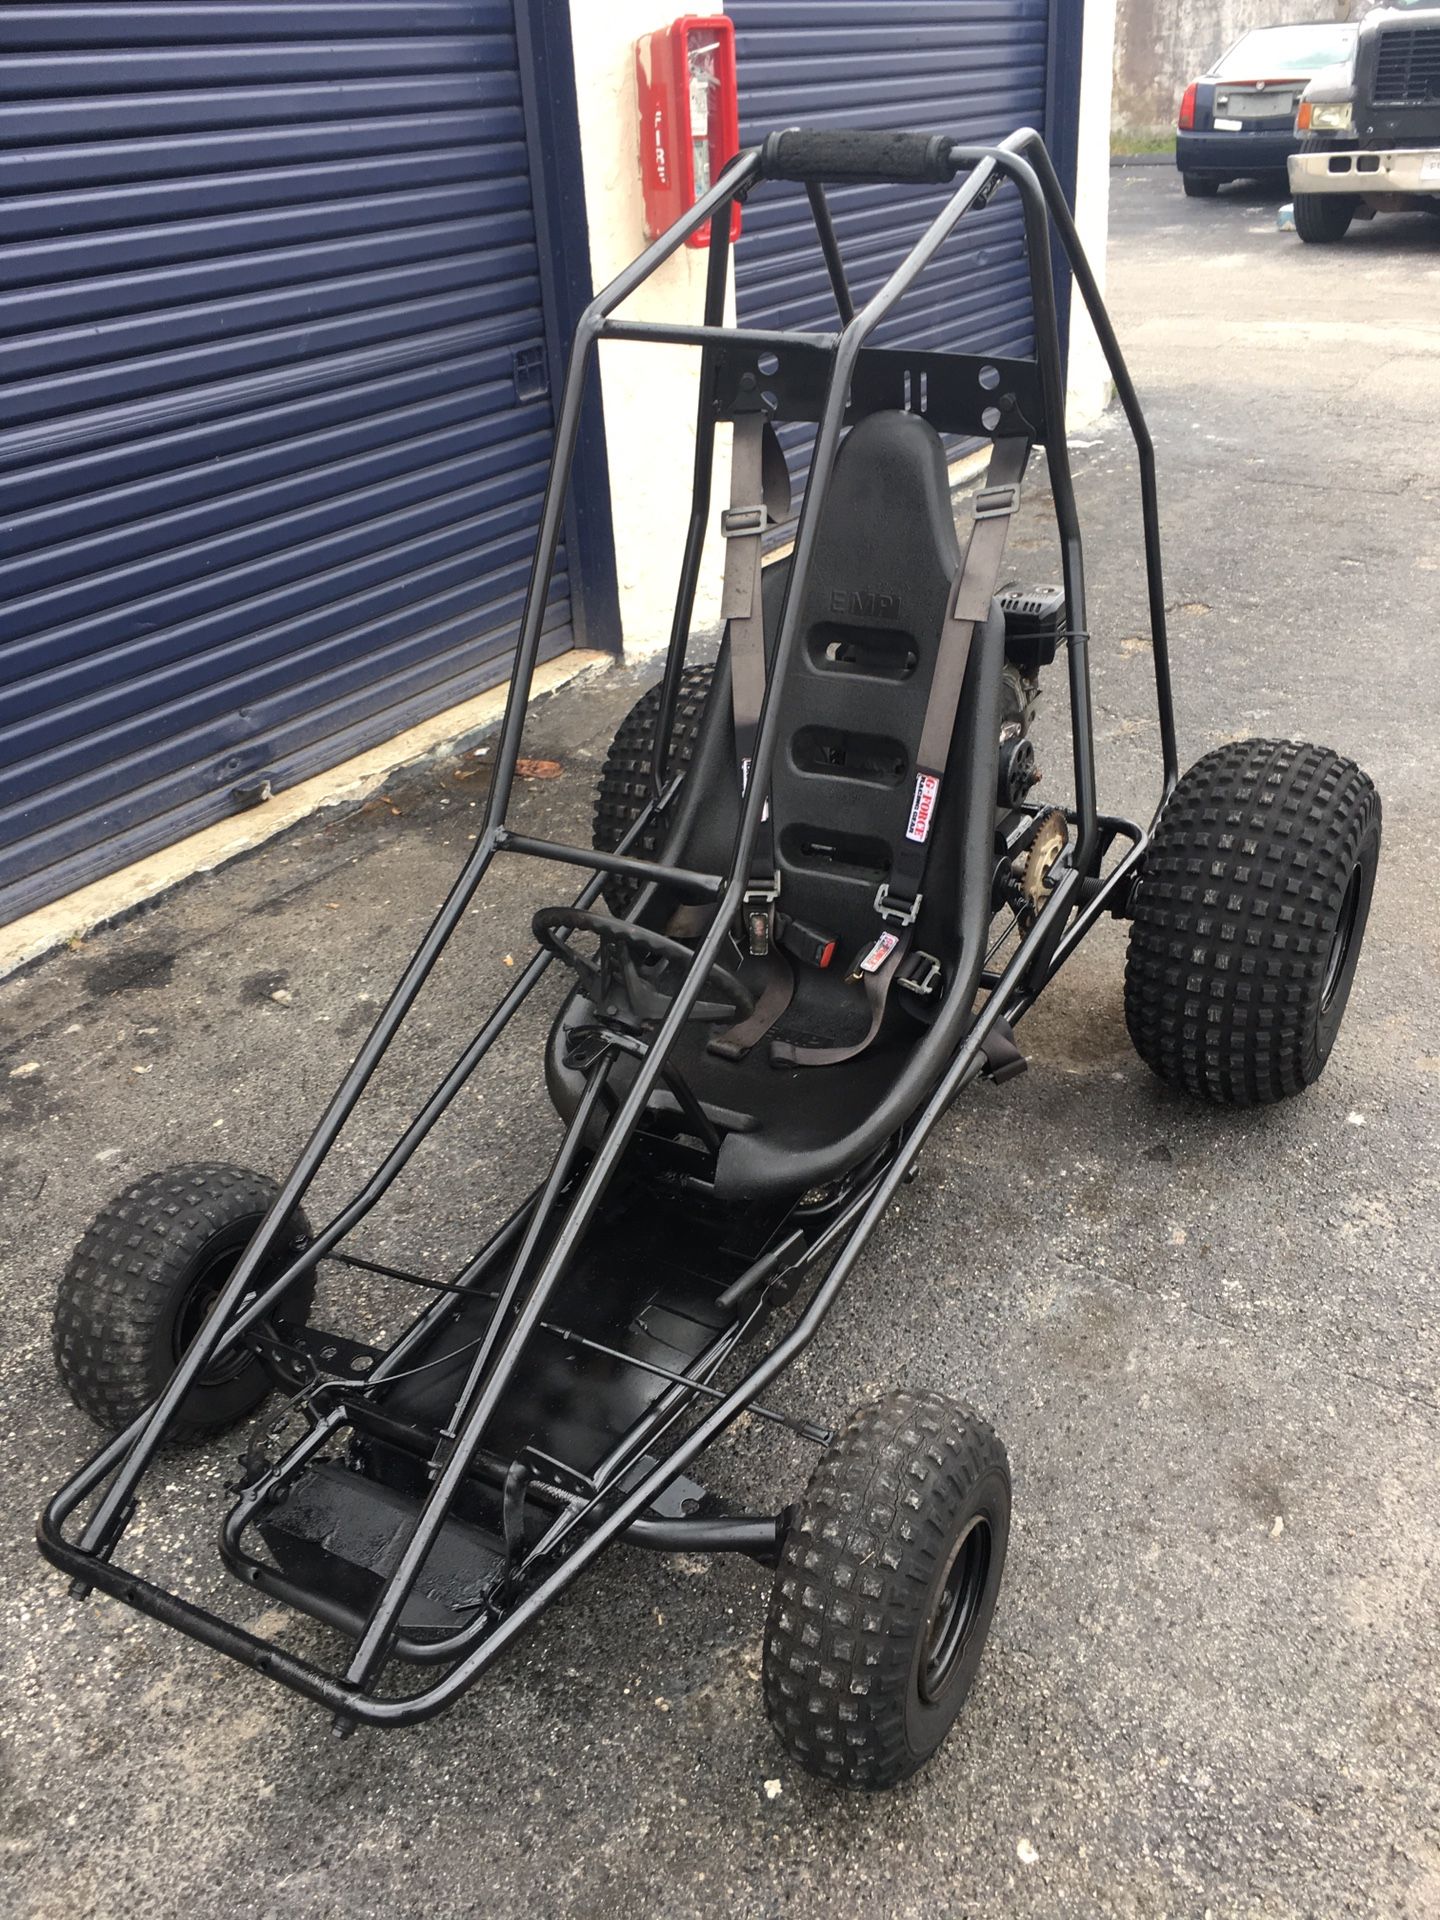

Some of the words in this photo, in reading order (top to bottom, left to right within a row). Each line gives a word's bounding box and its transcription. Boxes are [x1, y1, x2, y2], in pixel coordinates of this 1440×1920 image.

[829, 590, 903, 619] EMPI
[914, 776, 927, 810] RACING
[908, 811, 918, 834] GEAR
